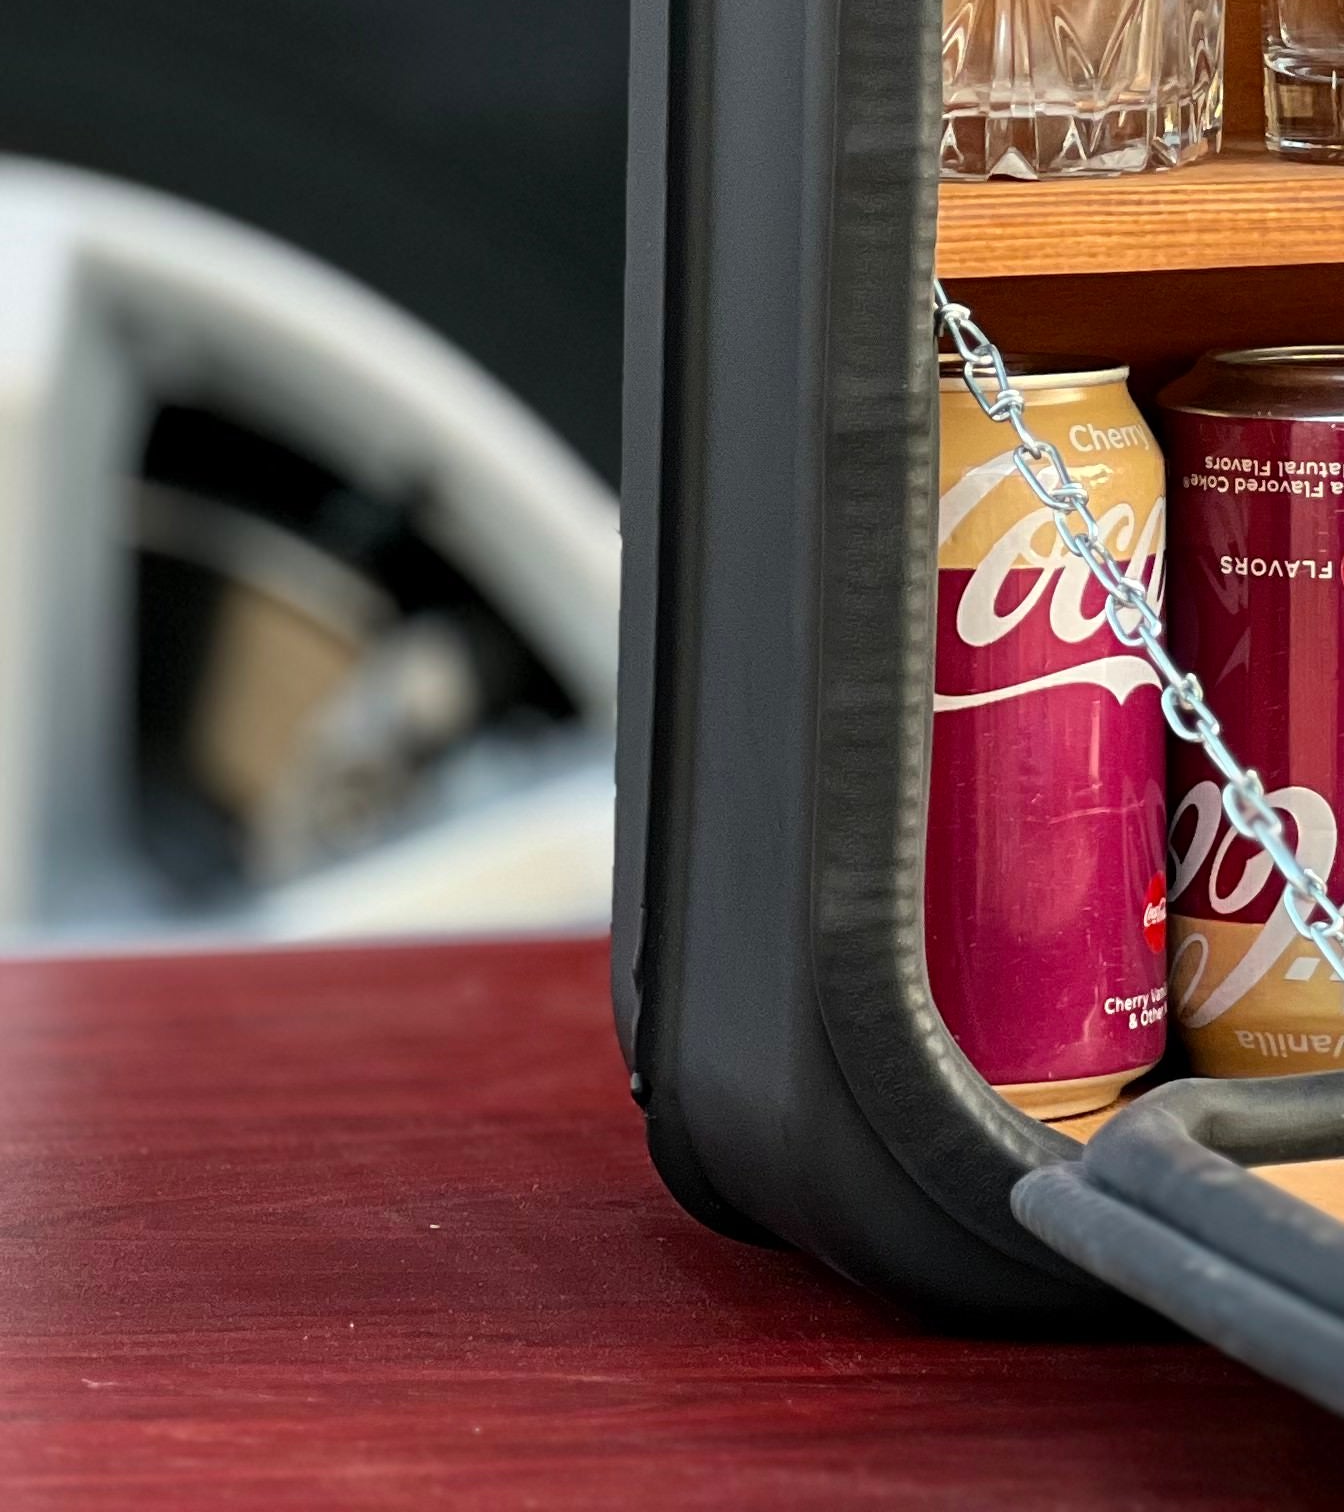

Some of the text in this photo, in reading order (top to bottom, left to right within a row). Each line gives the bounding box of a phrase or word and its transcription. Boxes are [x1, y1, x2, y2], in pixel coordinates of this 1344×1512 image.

[1068, 422, 1149, 453] Cherry
[1204, 455, 1271, 477] Flavors
[1234, 476, 1324, 499] Flavored
[1219, 554, 1334, 580] FLAVORS
[1104, 993, 1150, 1015] Cherry
[1128, 1012, 1138, 1030] &
